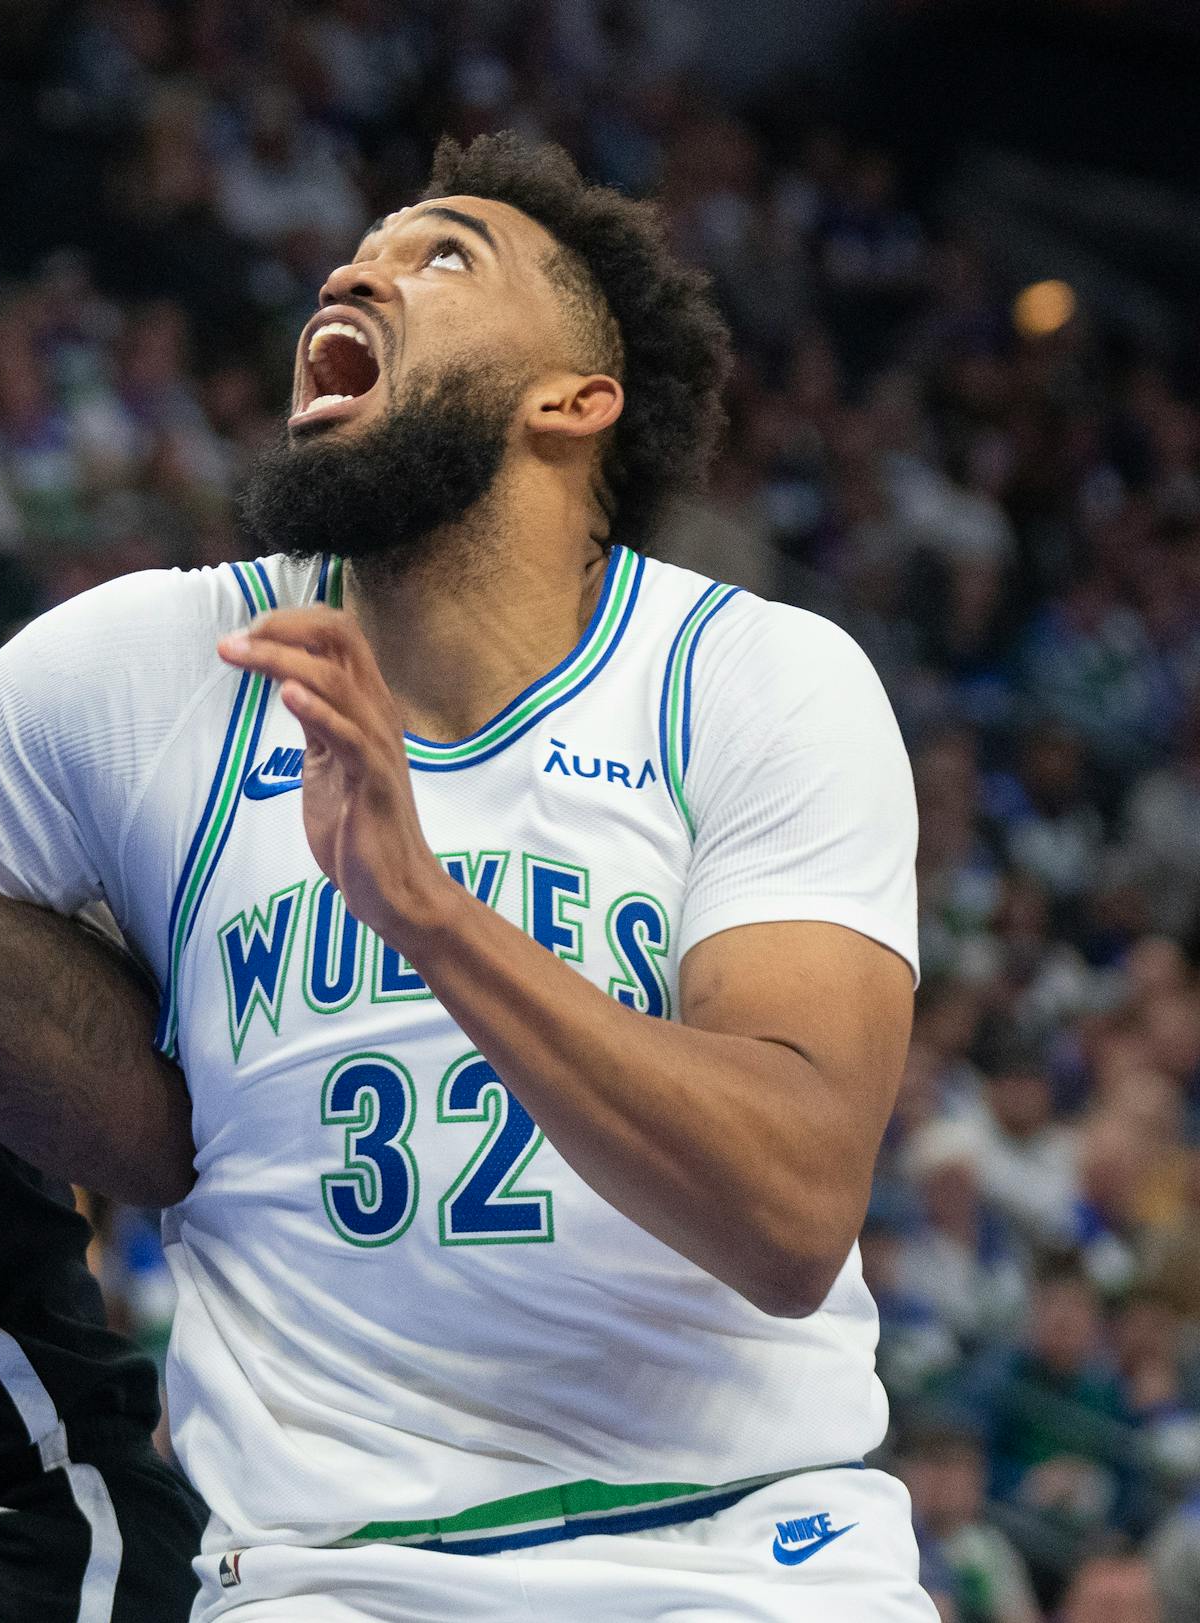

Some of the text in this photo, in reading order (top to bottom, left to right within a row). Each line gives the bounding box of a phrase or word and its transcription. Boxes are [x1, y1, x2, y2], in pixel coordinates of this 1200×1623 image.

[261, 746, 306, 778] NI
[320, 1050, 555, 1248] 32
[776, 1512, 835, 1544] NIKE
